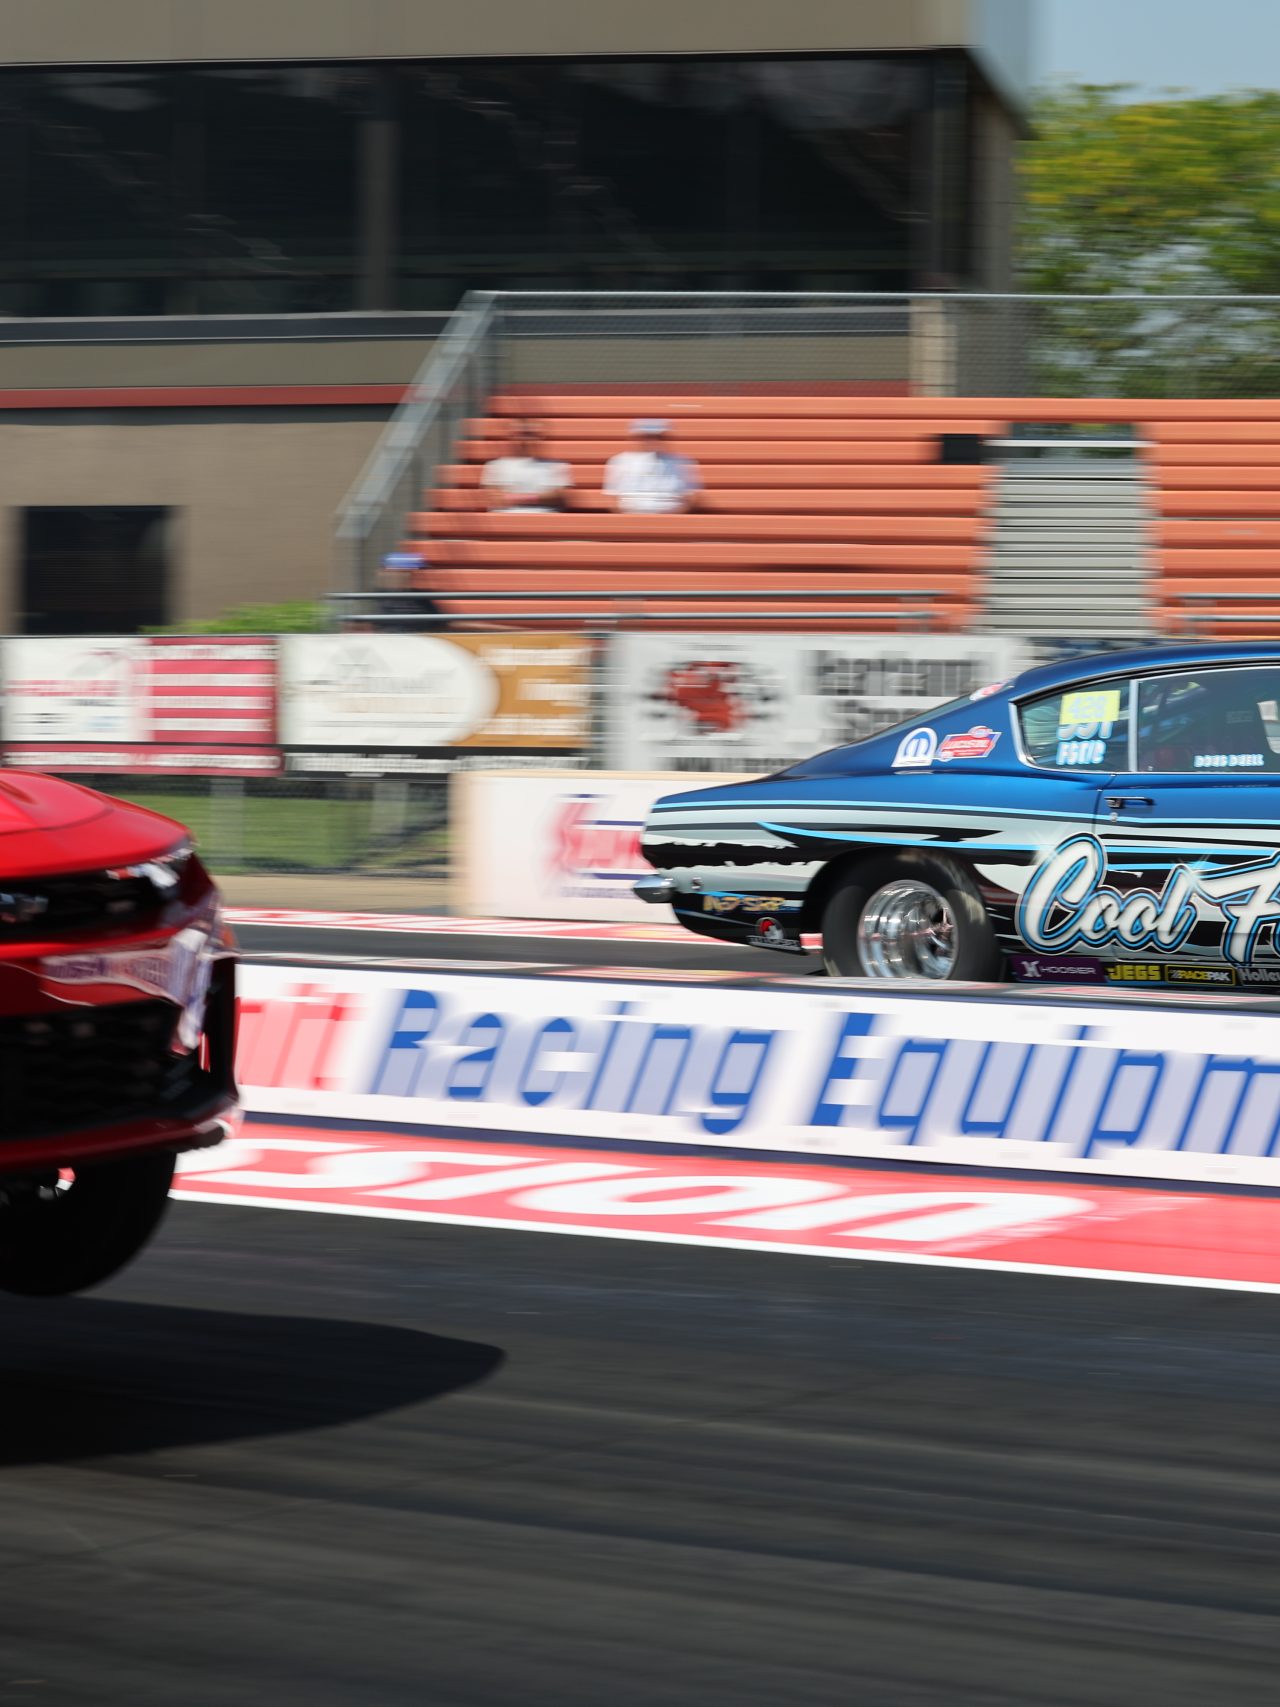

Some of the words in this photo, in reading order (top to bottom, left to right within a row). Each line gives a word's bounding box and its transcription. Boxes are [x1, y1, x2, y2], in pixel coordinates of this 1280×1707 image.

[1017, 833, 1198, 954] Cool
[1041, 966, 1096, 974] HOOSIER
[1107, 965, 1160, 980] JEGS
[1178, 970, 1231, 982] RACEPAK
[358, 987, 788, 1135] Racing
